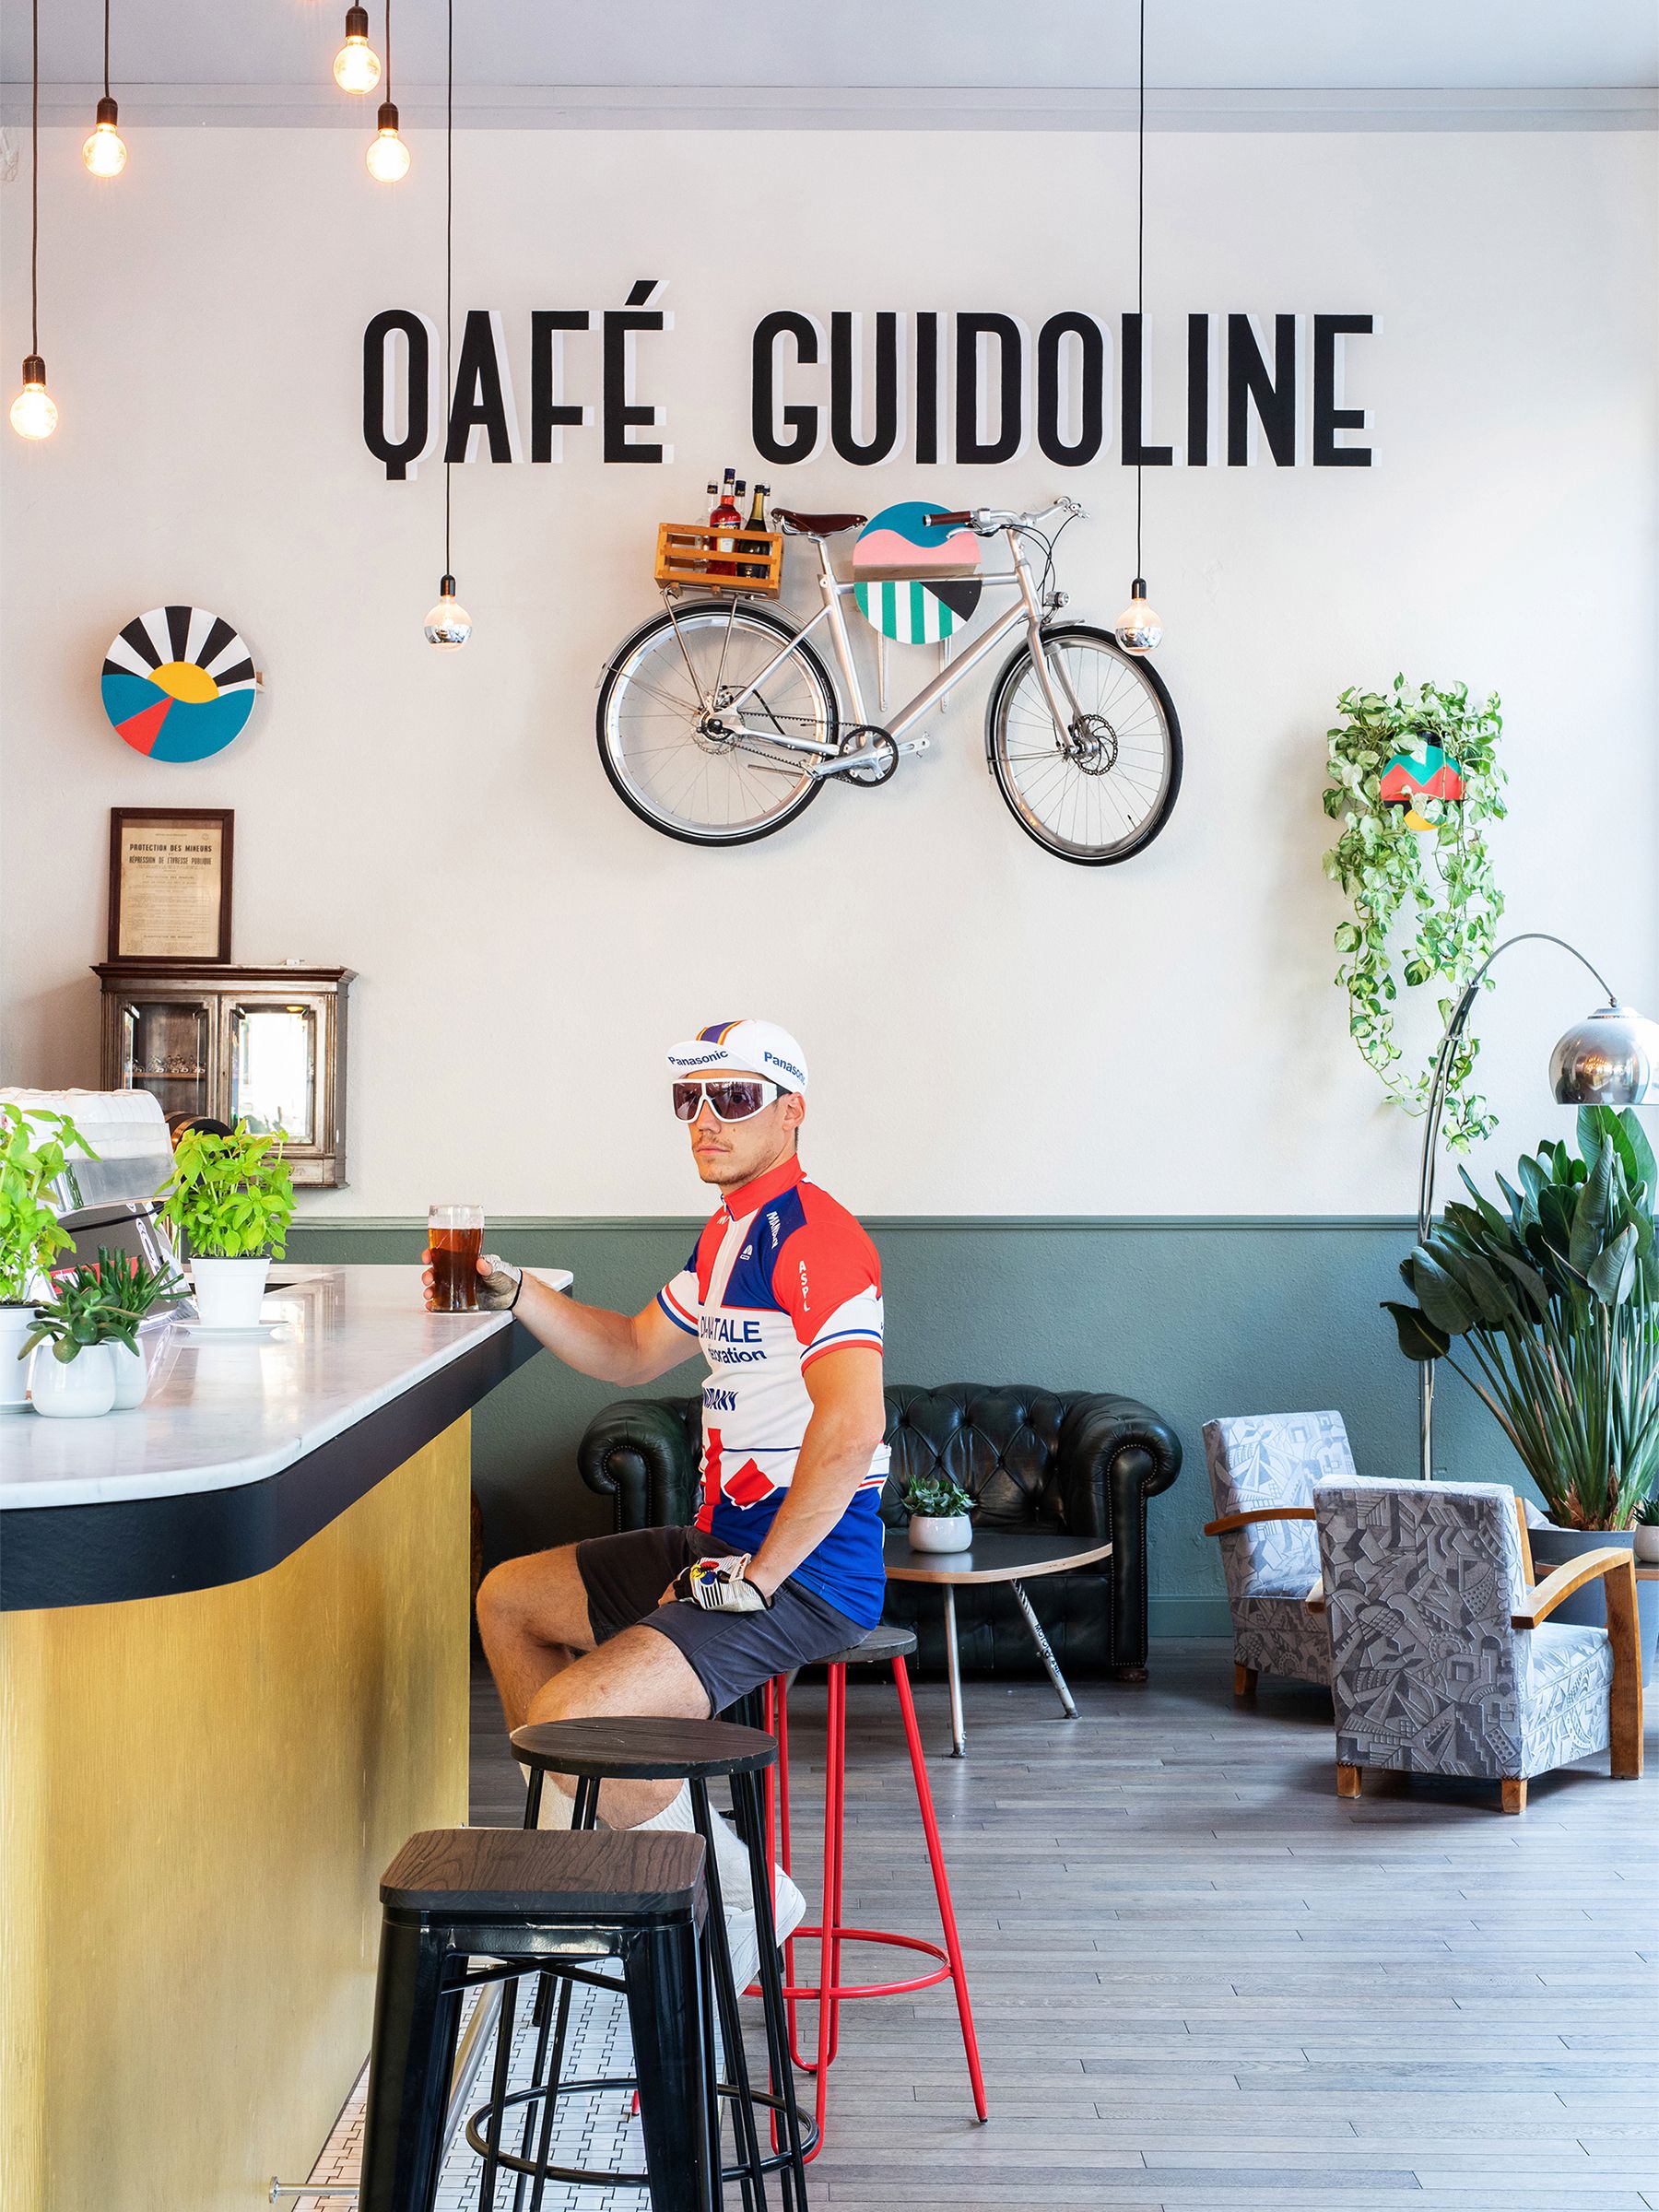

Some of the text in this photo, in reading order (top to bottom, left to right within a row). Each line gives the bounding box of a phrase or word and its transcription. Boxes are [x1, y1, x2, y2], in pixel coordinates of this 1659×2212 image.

[364, 280, 1373, 480] QAFÉ GUIDOLINE
[129, 843, 167, 852] PROTECTION
[667, 1050, 728, 1065] Panasonic
